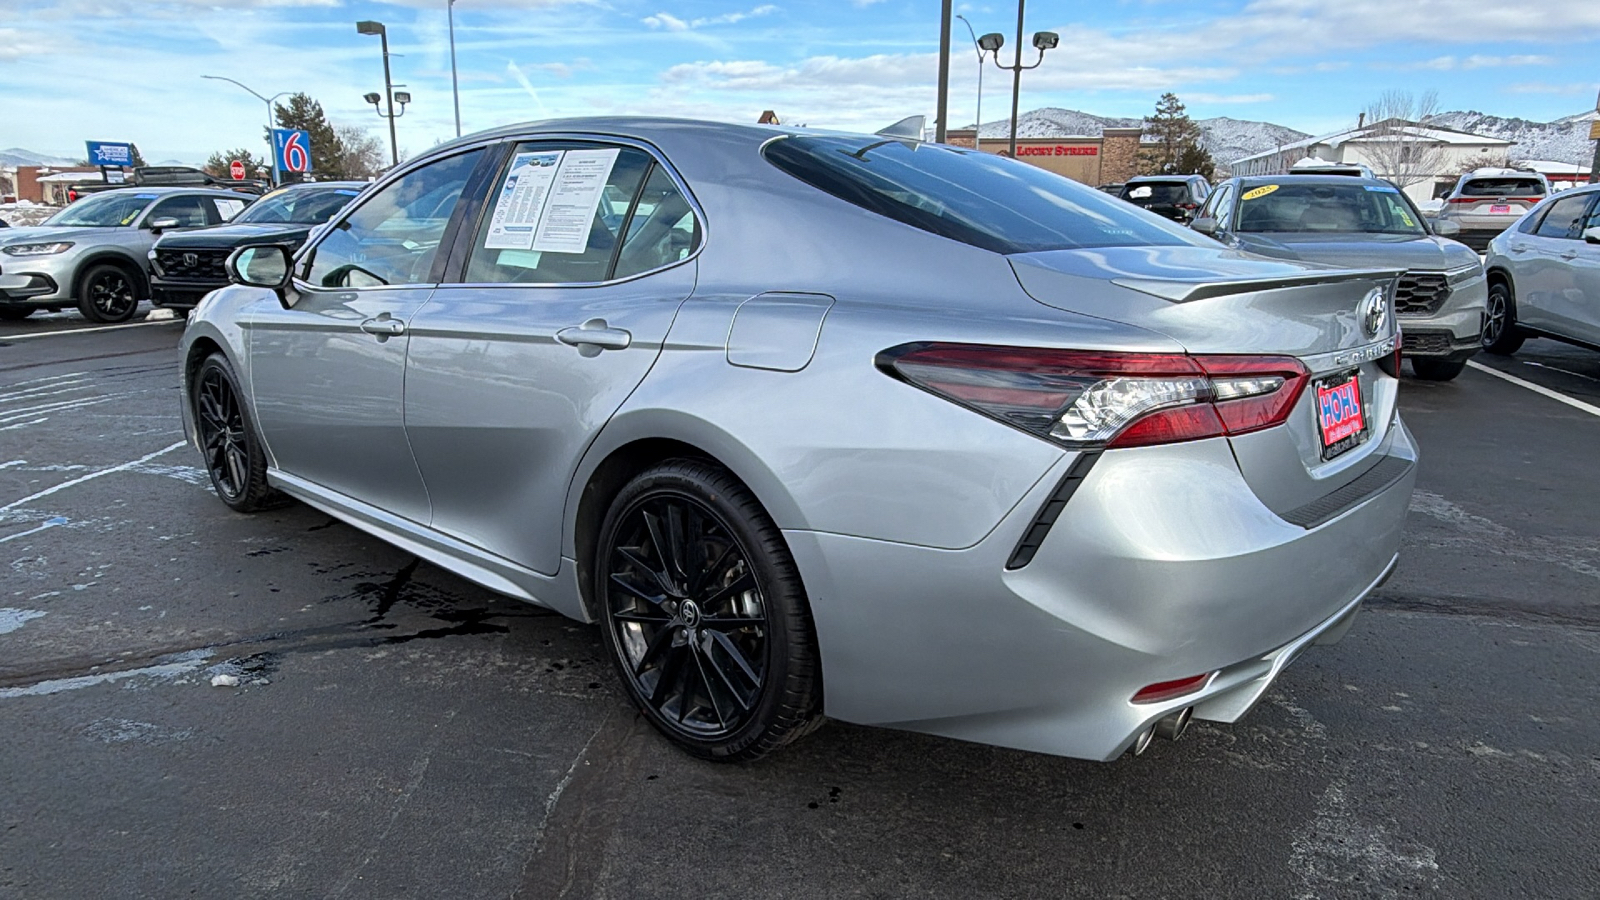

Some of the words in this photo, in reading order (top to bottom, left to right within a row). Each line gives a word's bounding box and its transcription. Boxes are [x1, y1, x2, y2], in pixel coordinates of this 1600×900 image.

[283, 131, 308, 173] 6
[1016, 145, 1054, 156] LUCKY
[1055, 144, 1098, 156] STRIKE
[231, 166, 244, 176] STOP
[1250, 186, 1273, 198] 2025
[1319, 384, 1359, 429] HOHL
